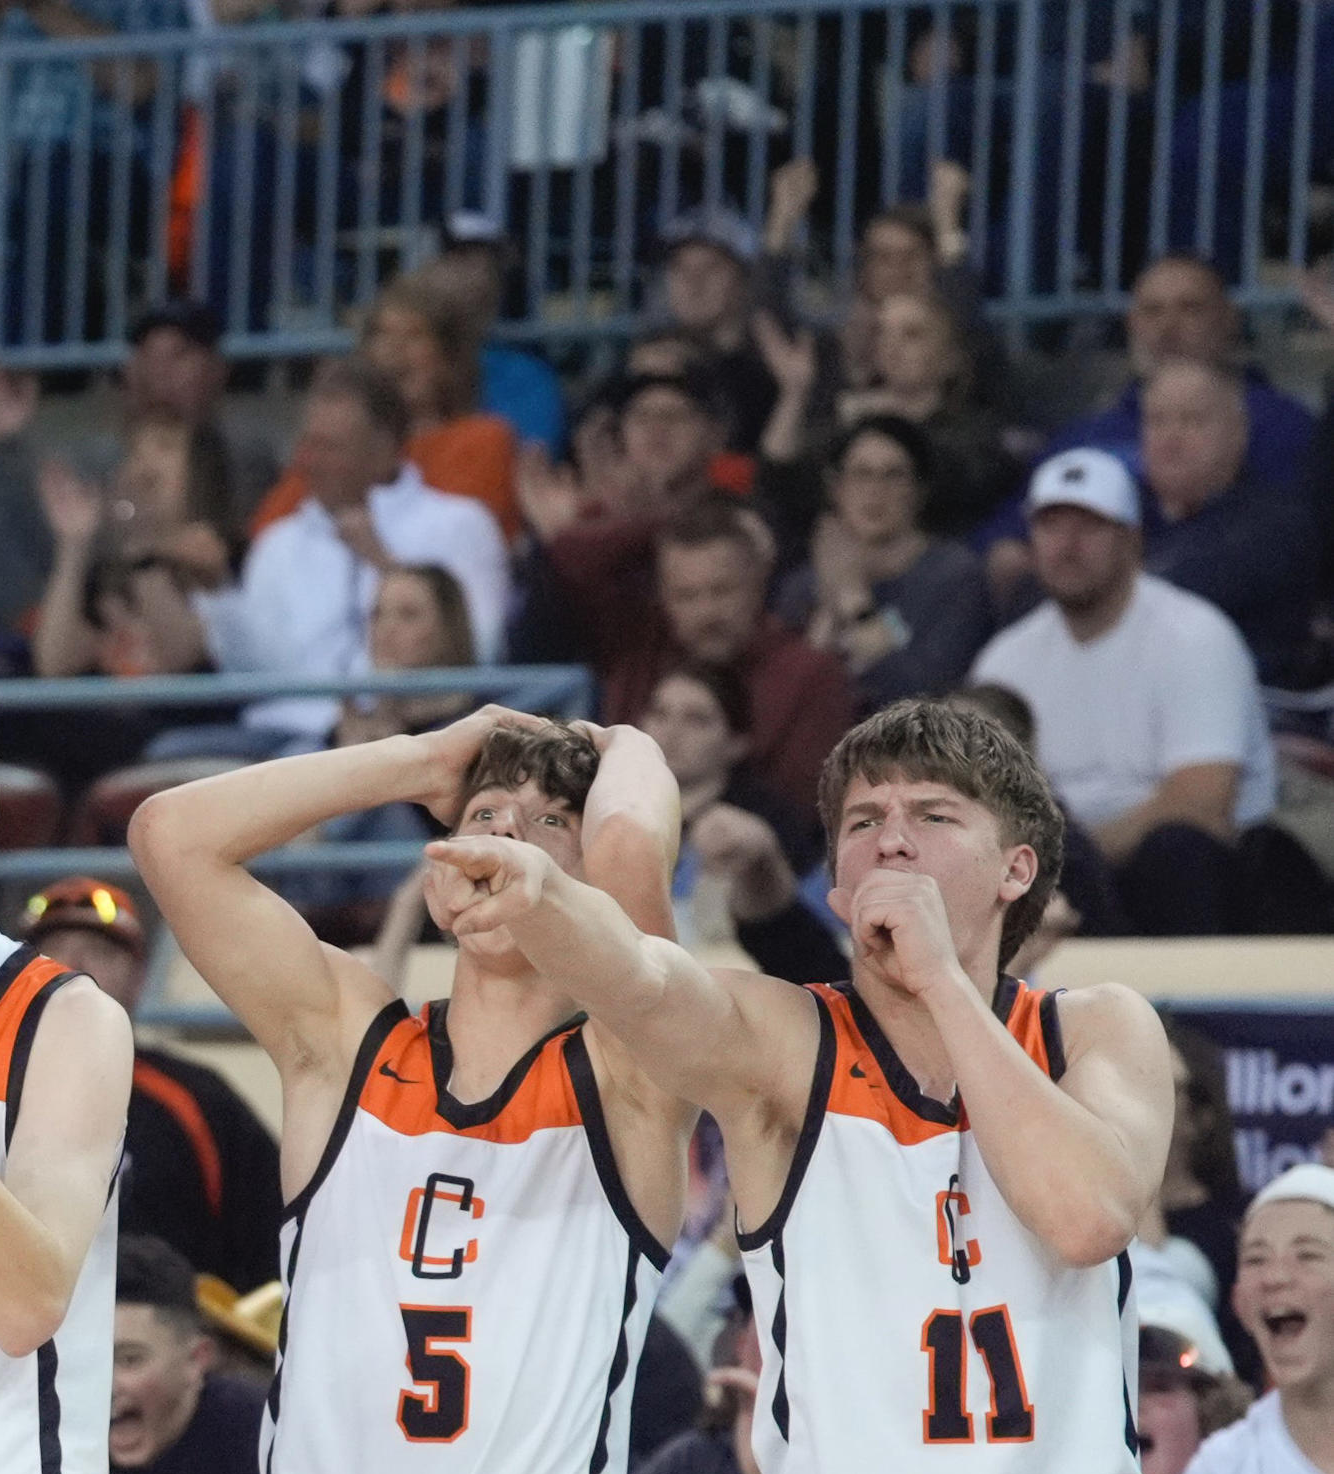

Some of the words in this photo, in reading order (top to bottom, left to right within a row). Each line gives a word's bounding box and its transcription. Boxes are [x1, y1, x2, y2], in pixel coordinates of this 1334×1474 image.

[398, 1172, 485, 1280] C
[396, 1304, 472, 1444] 5
[919, 1302, 1036, 1445] 11
